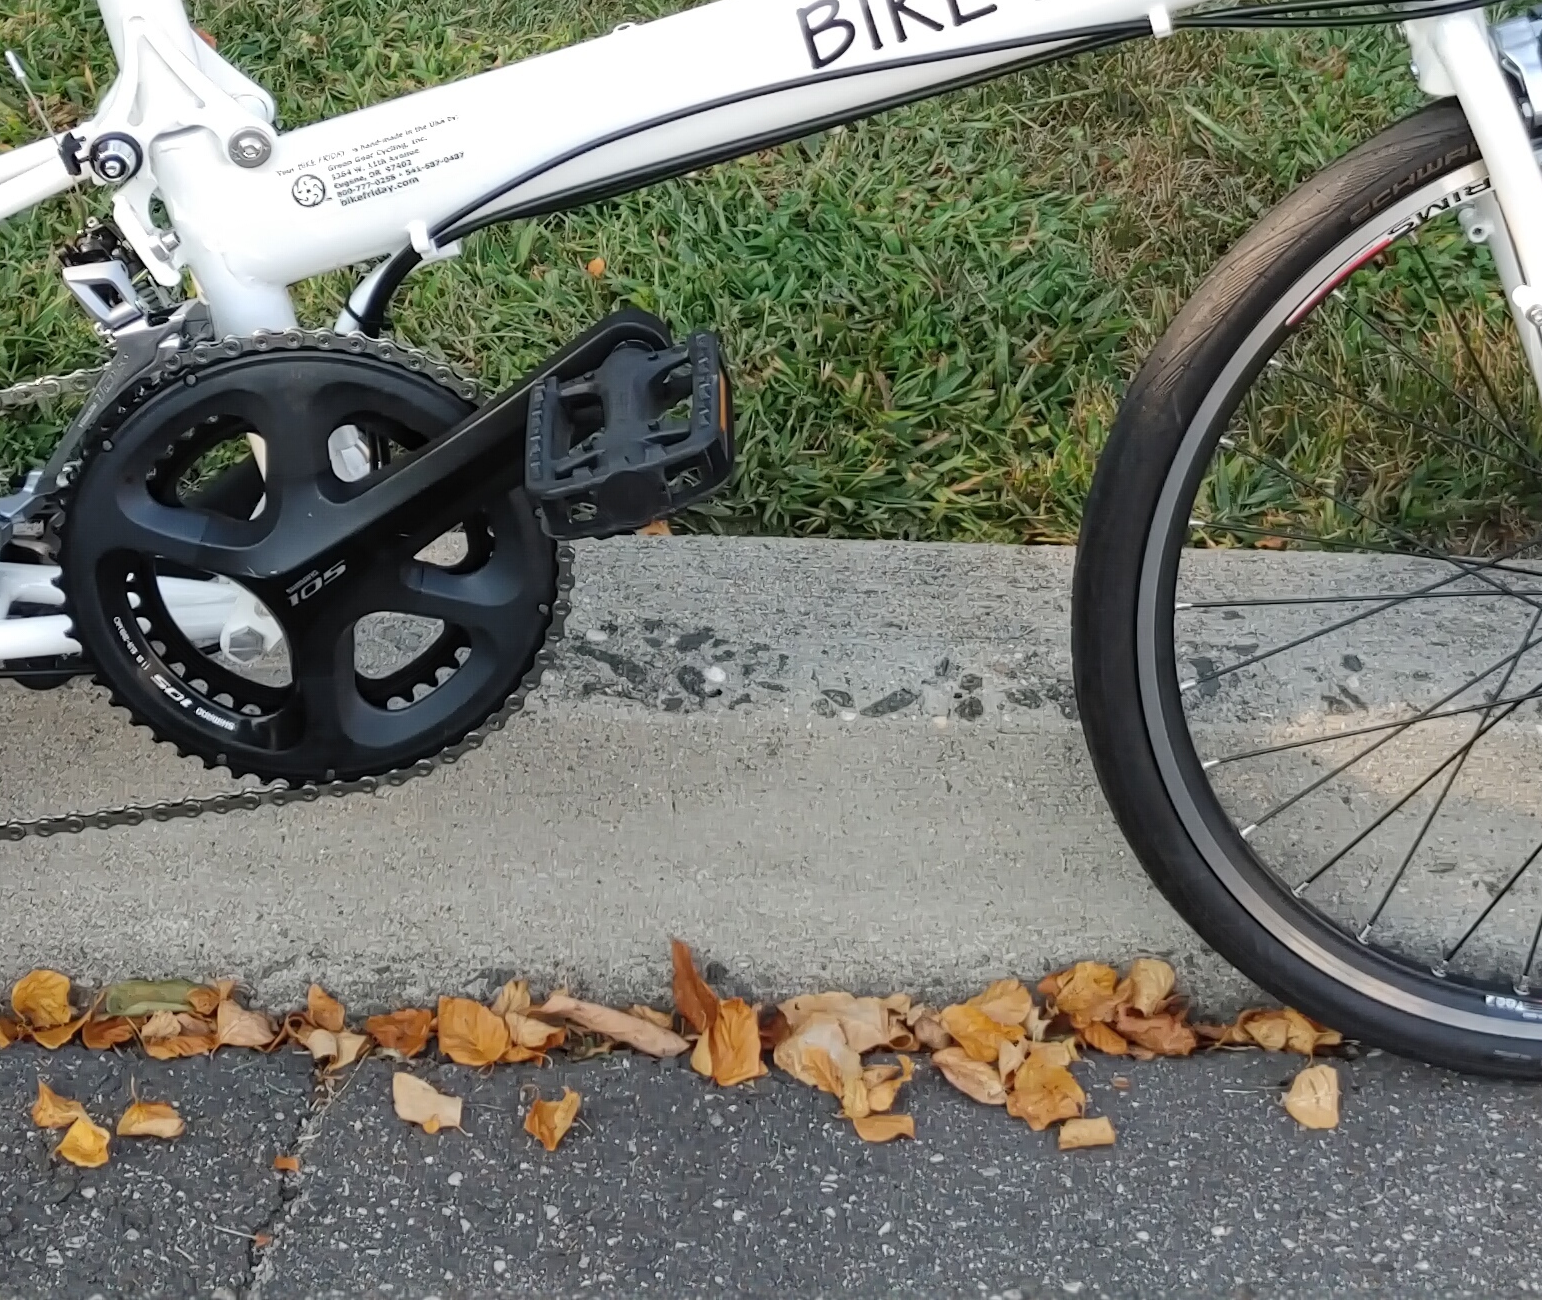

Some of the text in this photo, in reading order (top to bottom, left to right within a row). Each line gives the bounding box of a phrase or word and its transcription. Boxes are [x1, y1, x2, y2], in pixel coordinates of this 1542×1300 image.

[340, 176, 420, 207] bikefriday.com
[288, 559, 347, 607] 105
[149, 673, 194, 708] 105
